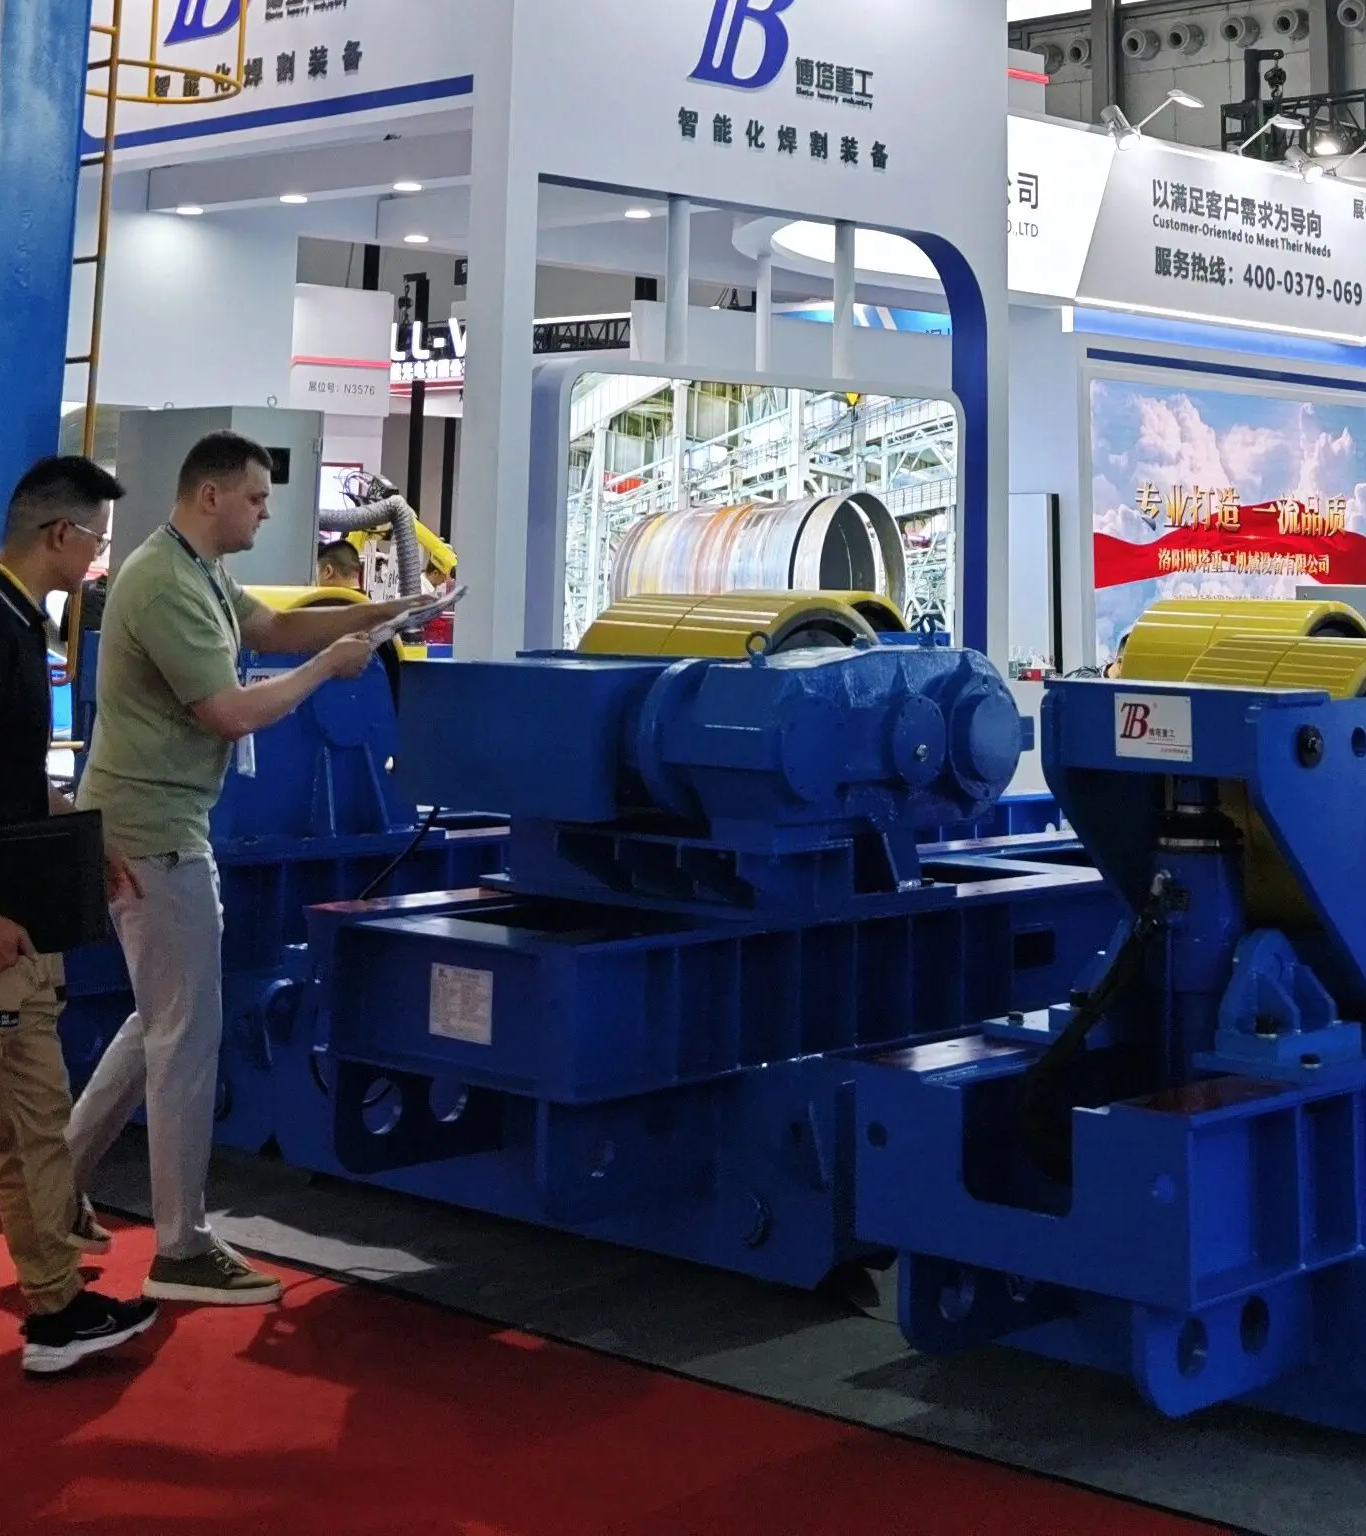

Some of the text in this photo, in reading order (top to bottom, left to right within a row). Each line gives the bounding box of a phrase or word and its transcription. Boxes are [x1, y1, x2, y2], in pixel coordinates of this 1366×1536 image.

[795, 56, 874, 98] 博塔重工
[678, 107, 889, 170] 智能化焊割装备
[1152, 178, 1322, 239] 以满足客户需求为导向
[1152, 214, 1332, 259] Customer-Oriented to Meet Their Needs
[1136, 480, 1349, 537] 专业打造 一流品质
